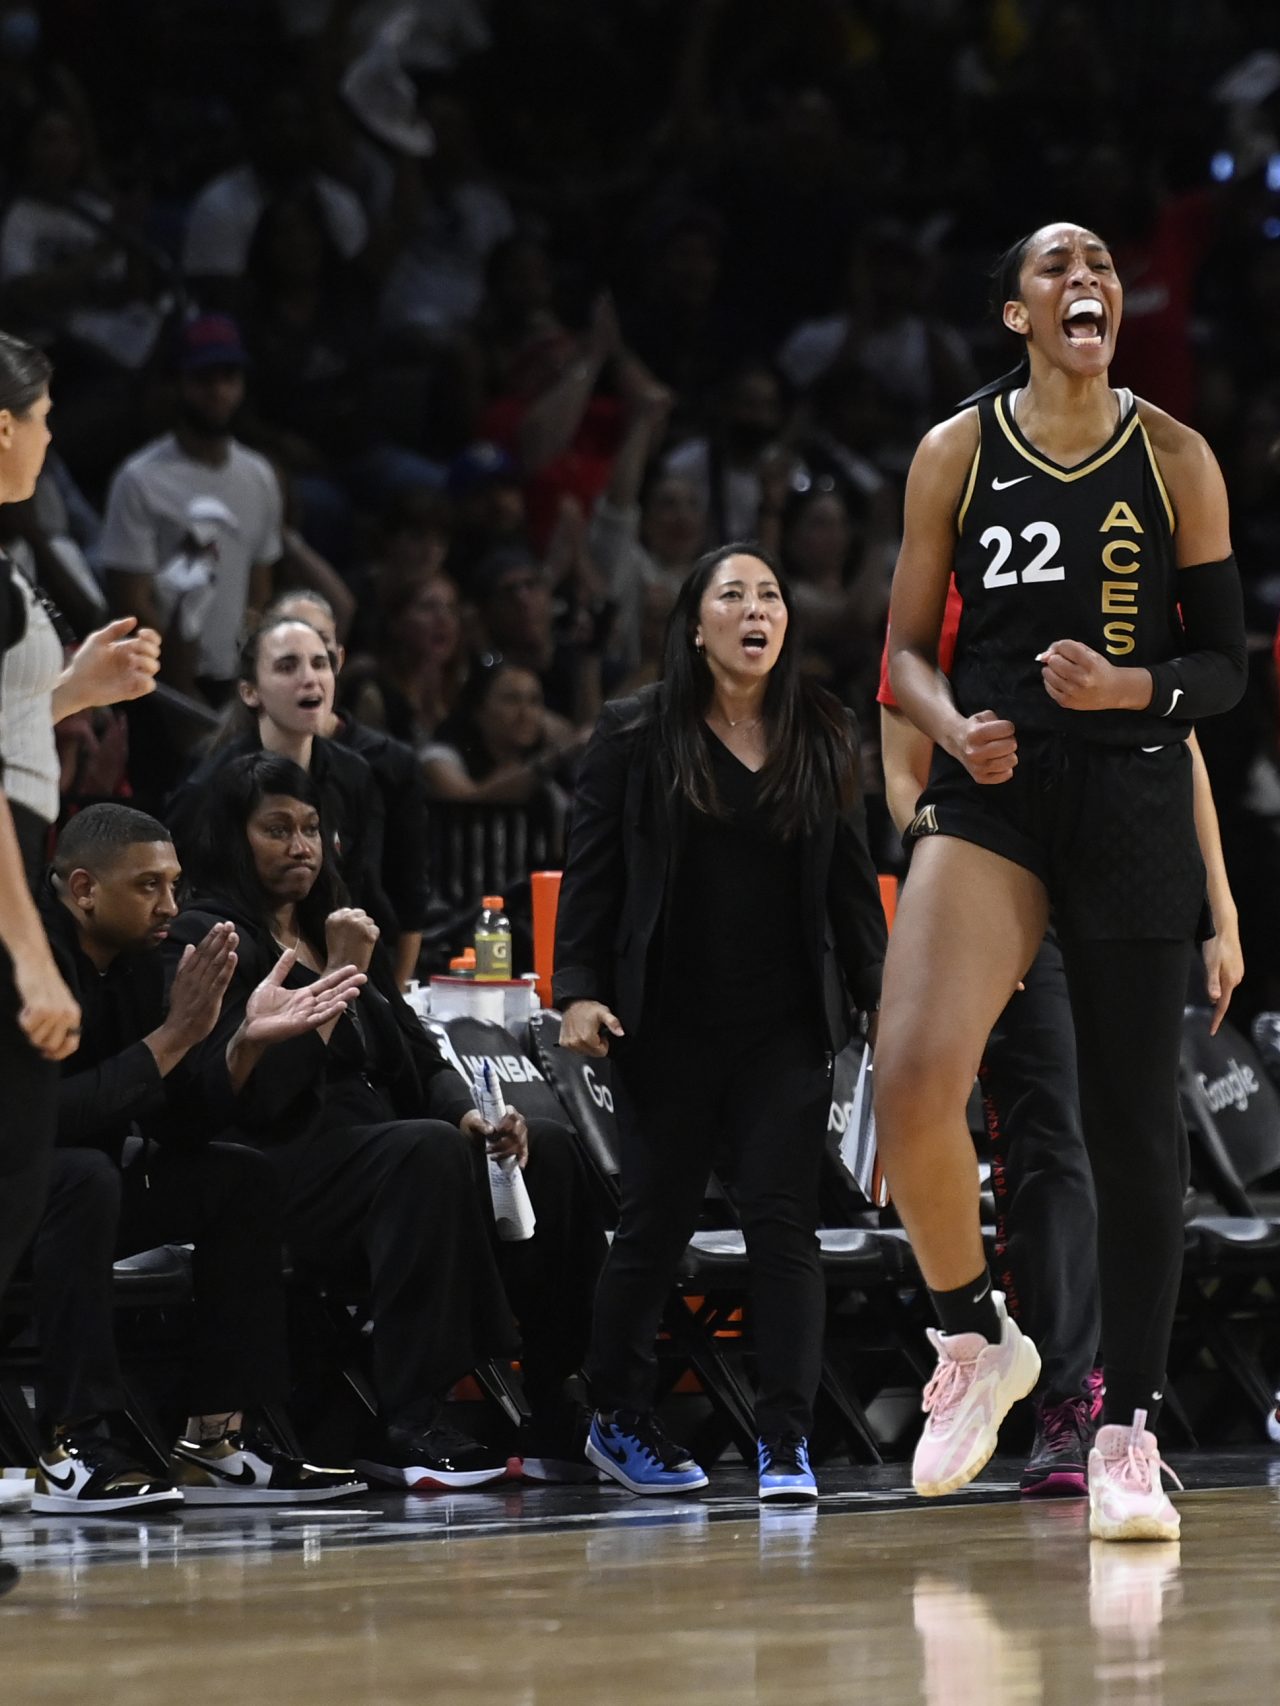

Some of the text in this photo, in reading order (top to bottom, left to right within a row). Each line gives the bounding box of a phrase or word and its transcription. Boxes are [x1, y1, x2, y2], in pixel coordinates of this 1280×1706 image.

[979, 521, 1065, 589] 22
[1099, 501, 1144, 656] ACES
[493, 942, 507, 959] G
